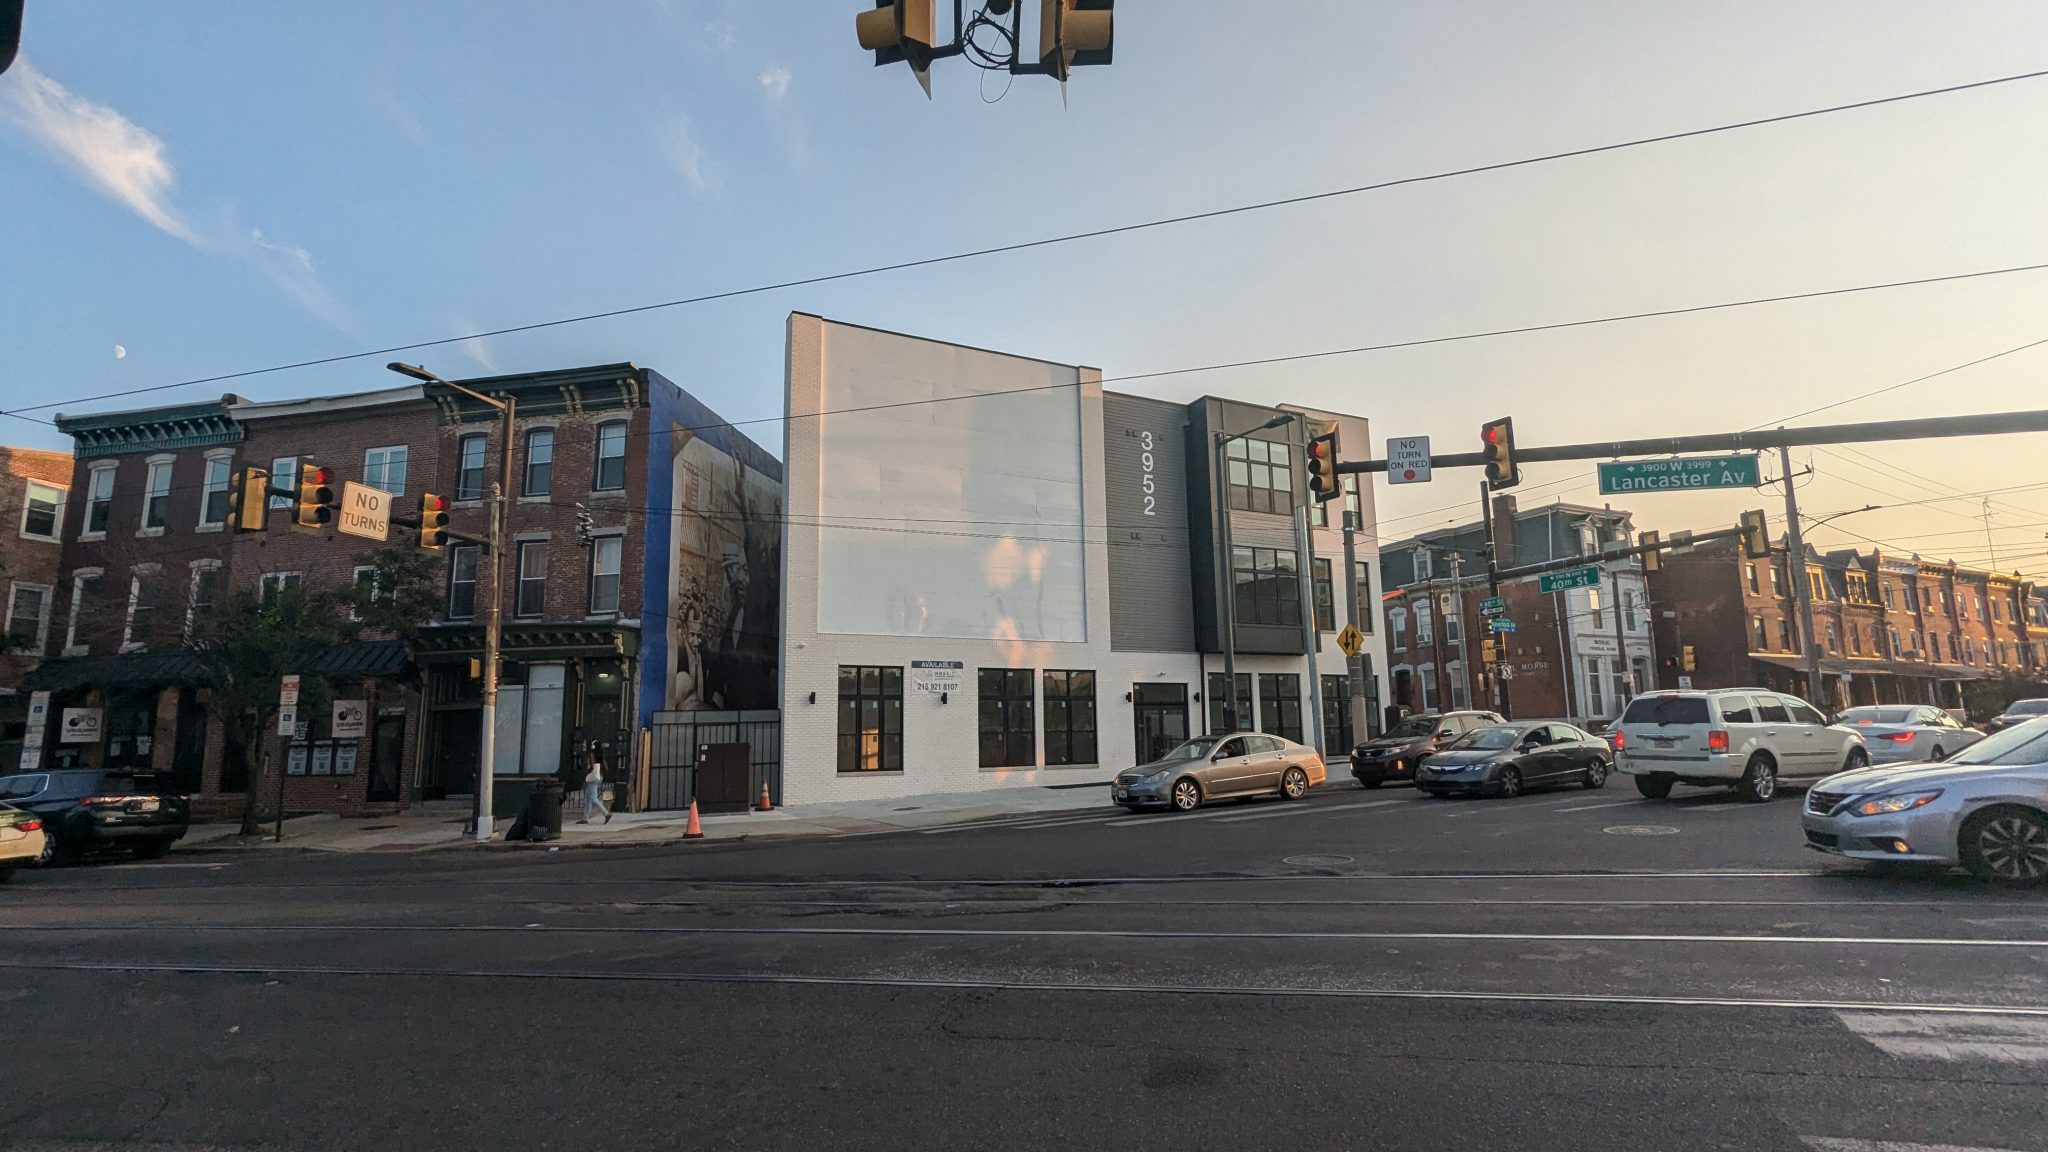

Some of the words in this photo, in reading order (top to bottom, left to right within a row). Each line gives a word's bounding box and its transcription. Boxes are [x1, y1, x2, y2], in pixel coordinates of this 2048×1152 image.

[1400, 440, 1416, 450] NO
[1397, 450, 1421, 460] TURN
[1390, 461, 1404, 470] ON
[1408, 460, 1428, 469] RED
[1641, 463, 1667, 472] 3900
[1669, 461, 1683, 472] W
[1686, 460, 1712, 470] 3999
[1141, 430, 1156, 516] 3952
[1611, 471, 1711, 491] Lancaster
[1720, 470, 1746, 484] Av
[355, 492, 379, 511] NO
[344, 511, 385, 533] TURNS
[1576, 575, 1588, 586] St
[917, 682, 929, 691] 215
[930, 683, 941, 691] 921
[942, 683, 959, 691] 8107
